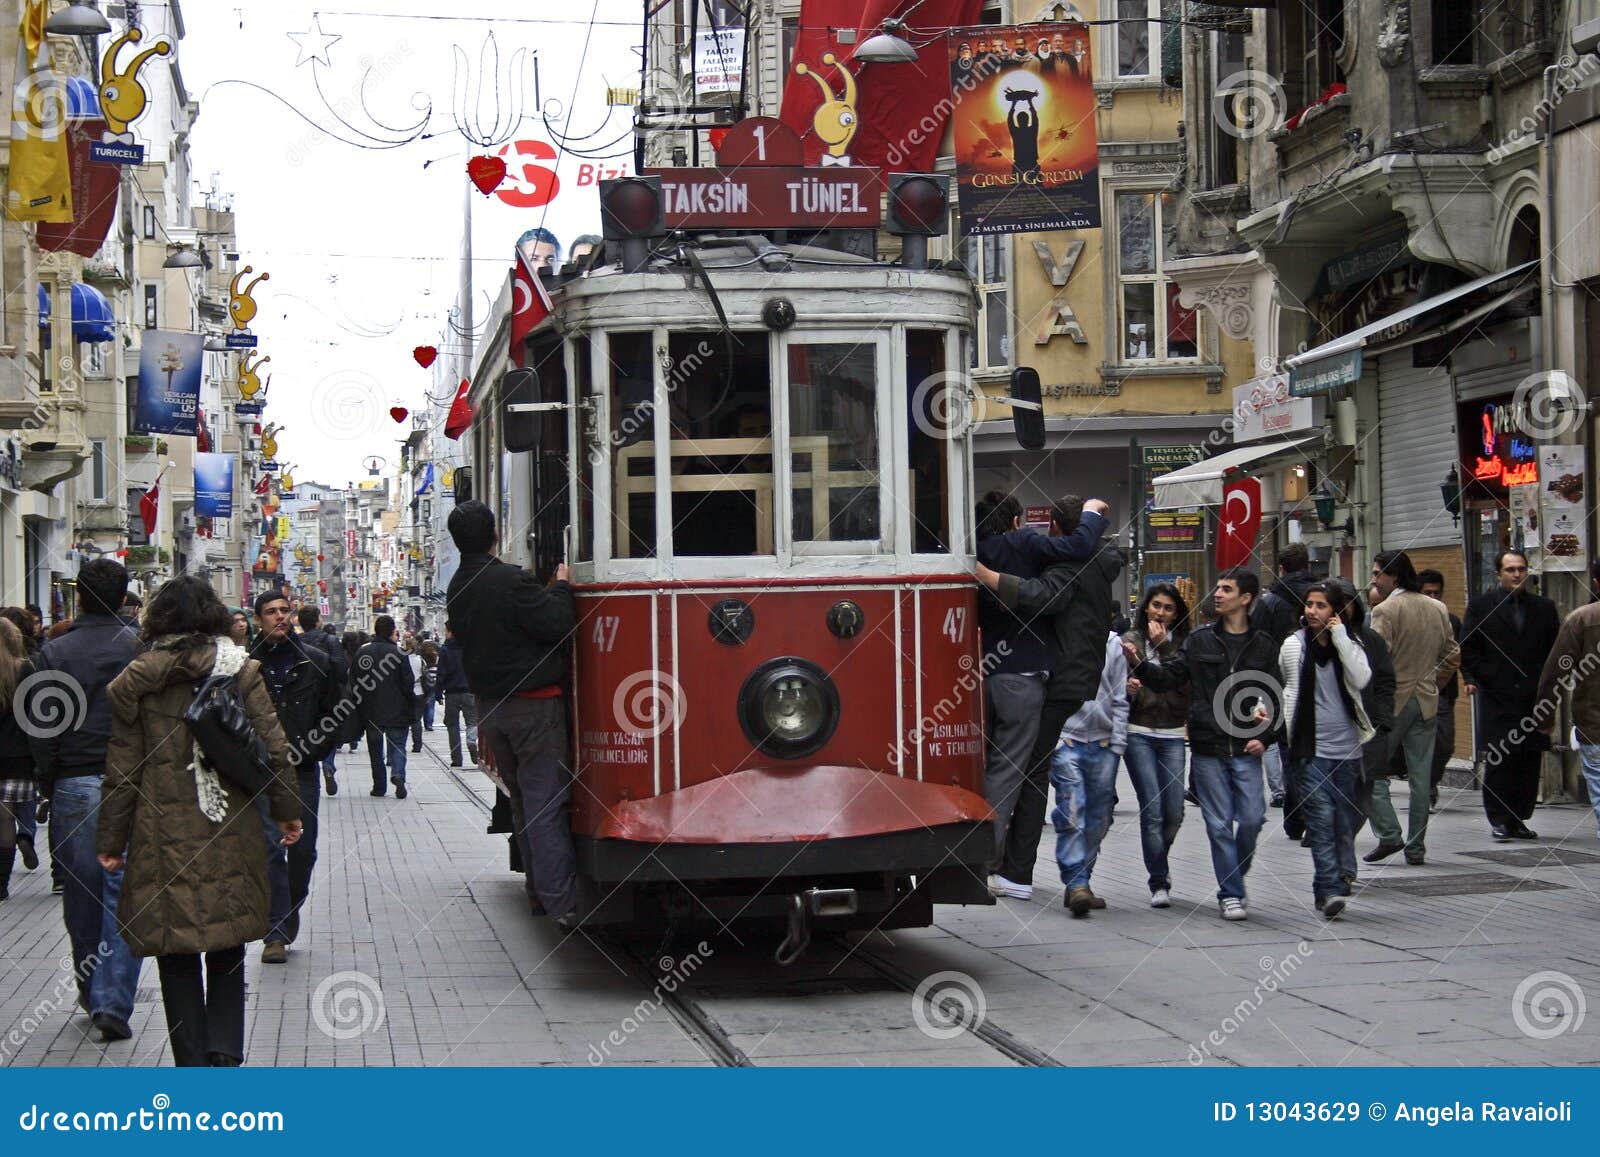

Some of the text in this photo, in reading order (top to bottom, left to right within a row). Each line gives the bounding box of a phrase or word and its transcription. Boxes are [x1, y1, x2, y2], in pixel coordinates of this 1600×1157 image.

[95, 147, 140, 159] TURKCELL
[752, 125, 766, 161] 1
[661, 177, 868, 214] TAKSİM TÜNEL
[592, 615, 621, 652] 47
[943, 606, 966, 644] 47
[929, 742, 942, 757] VE
